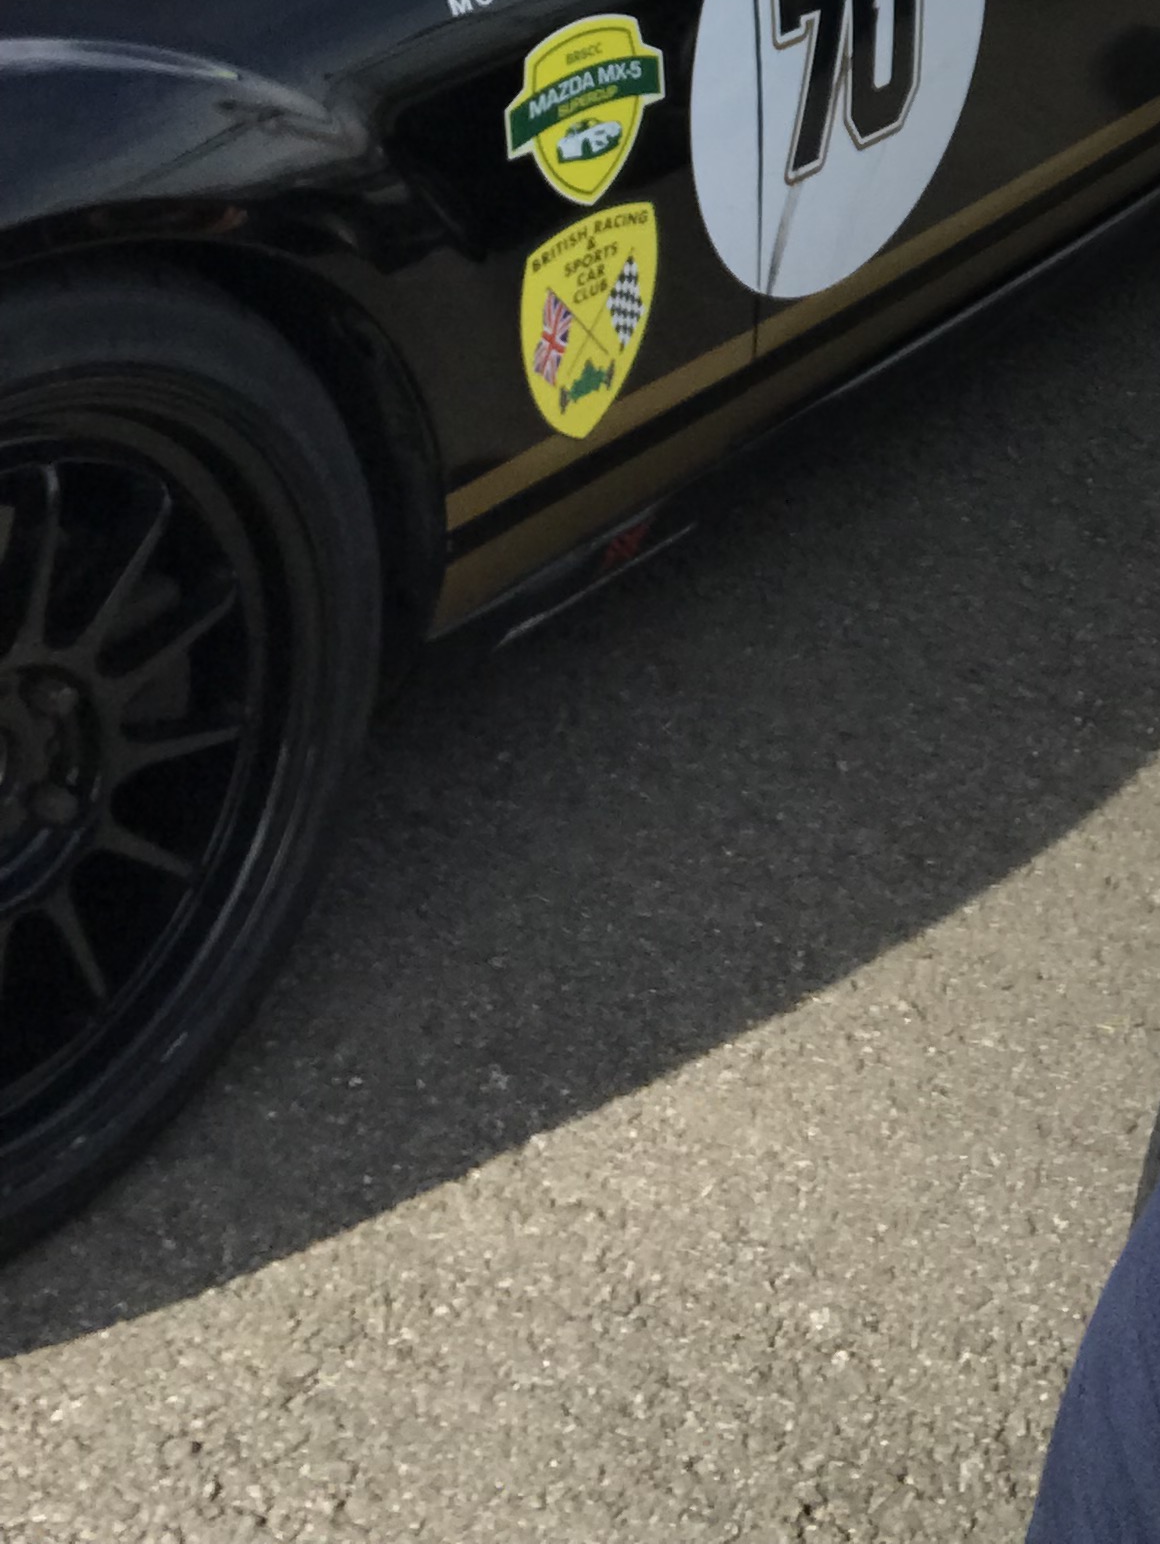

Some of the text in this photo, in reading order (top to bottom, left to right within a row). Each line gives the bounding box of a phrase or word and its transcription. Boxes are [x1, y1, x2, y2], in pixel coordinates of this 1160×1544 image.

[528, 60, 643, 120] MAZDA MX-5
[532, 209, 649, 274] BRITISH RACING
[564, 241, 618, 278] SPORTS
[573, 277, 608, 304] CLUB
[577, 263, 605, 287] CAR
